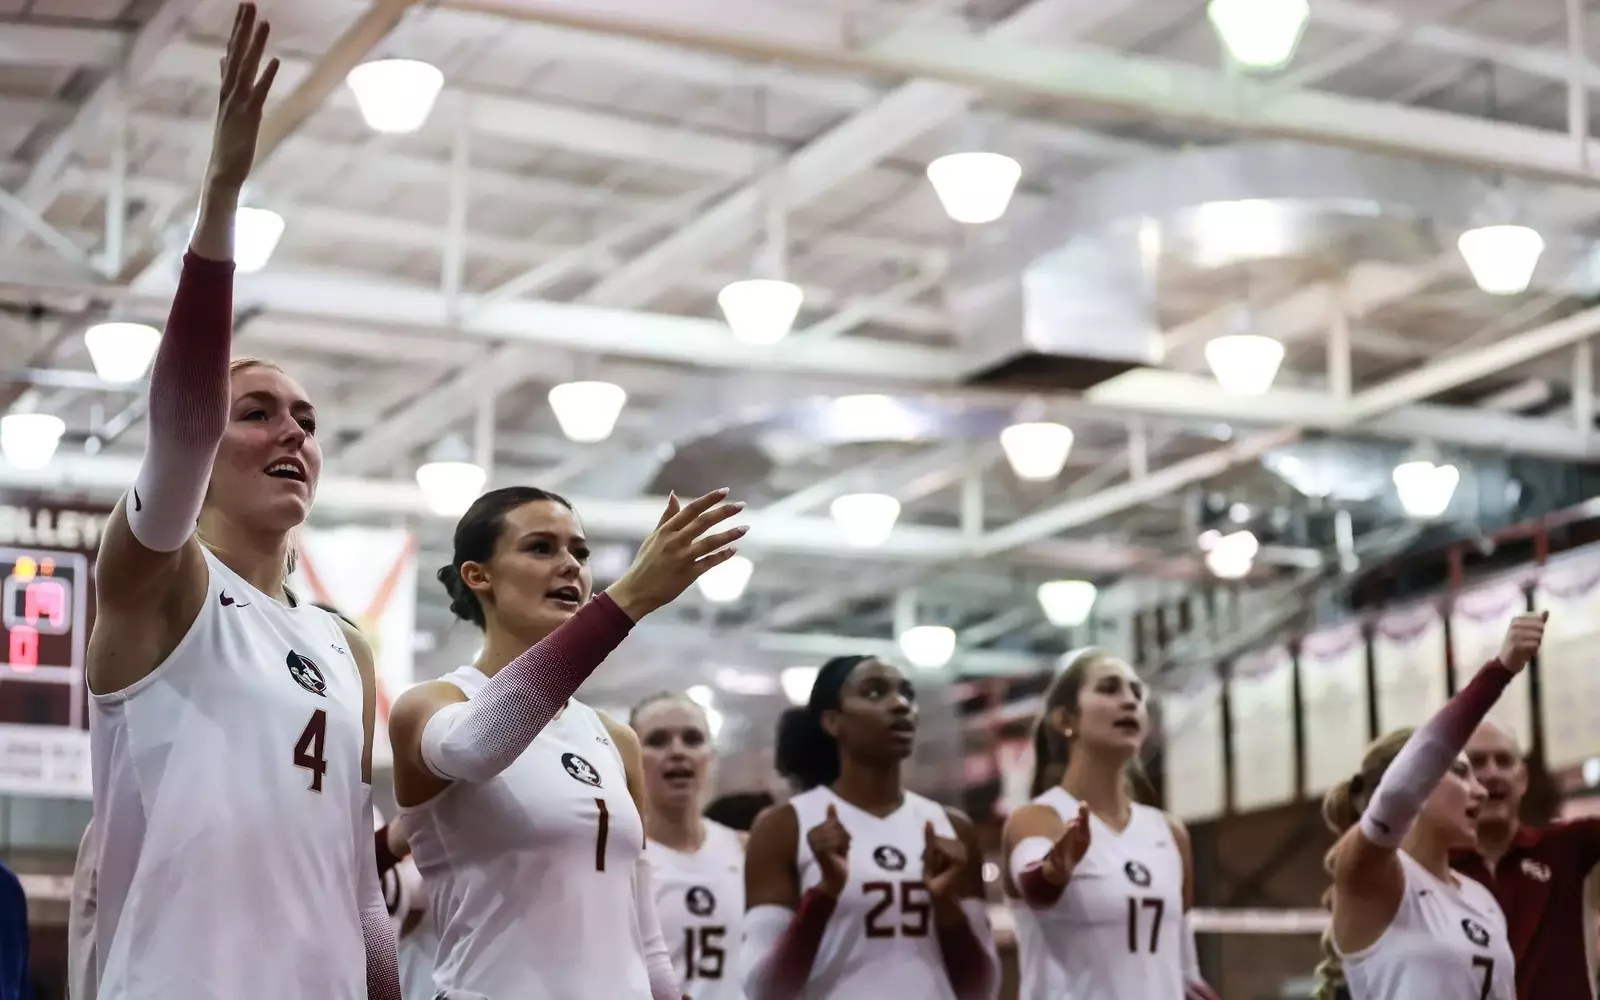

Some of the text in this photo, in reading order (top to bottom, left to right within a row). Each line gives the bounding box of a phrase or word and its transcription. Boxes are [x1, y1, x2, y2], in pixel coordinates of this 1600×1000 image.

[292, 706, 328, 795] 4
[594, 797, 609, 872] 1
[862, 881, 929, 938] 25
[1127, 897, 1164, 953] 17
[684, 925, 726, 979] 15
[1472, 954, 1495, 1000] 7
